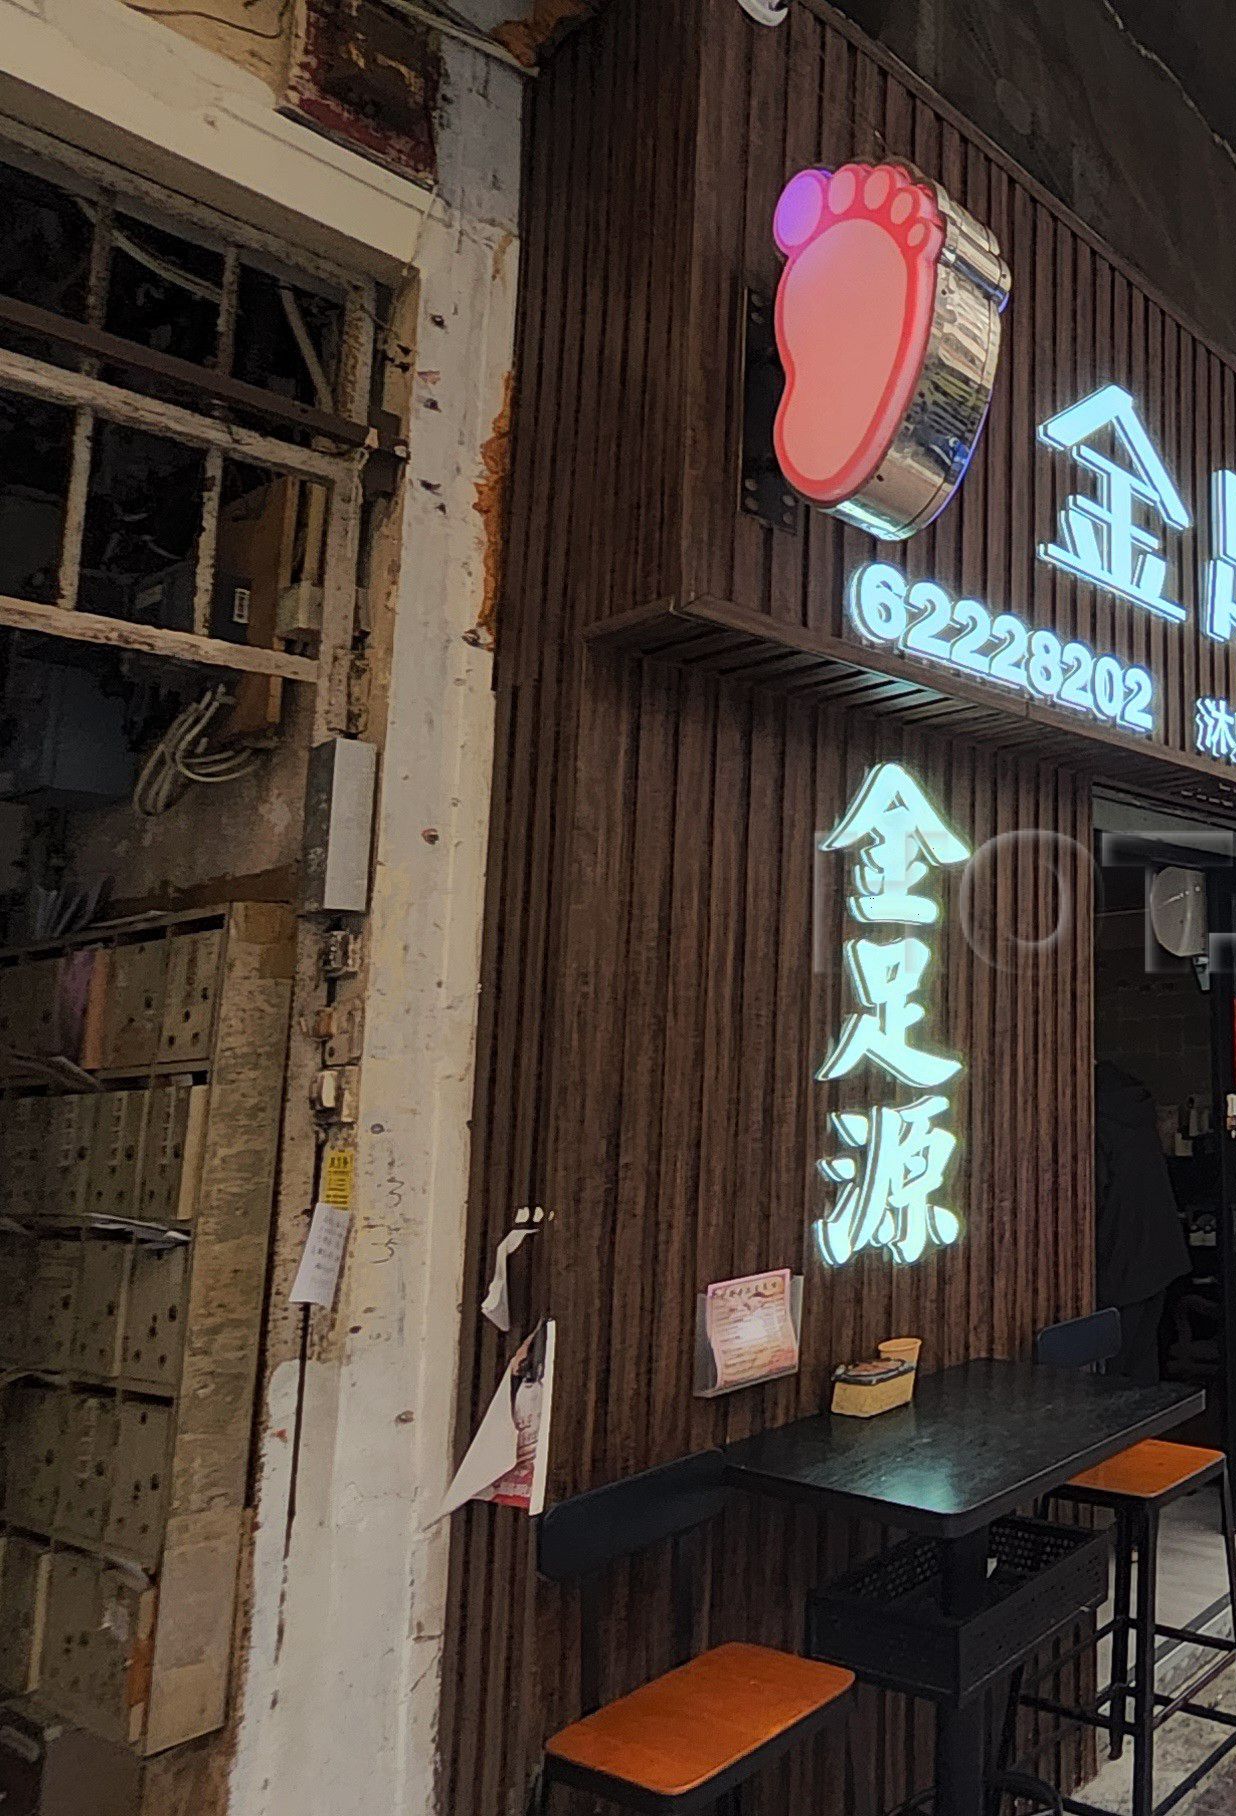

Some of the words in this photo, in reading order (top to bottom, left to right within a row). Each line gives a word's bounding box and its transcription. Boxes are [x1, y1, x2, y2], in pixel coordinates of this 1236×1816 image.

[850, 562, 1155, 734] 62228202
[814, 761, 972, 1268] 金足源
